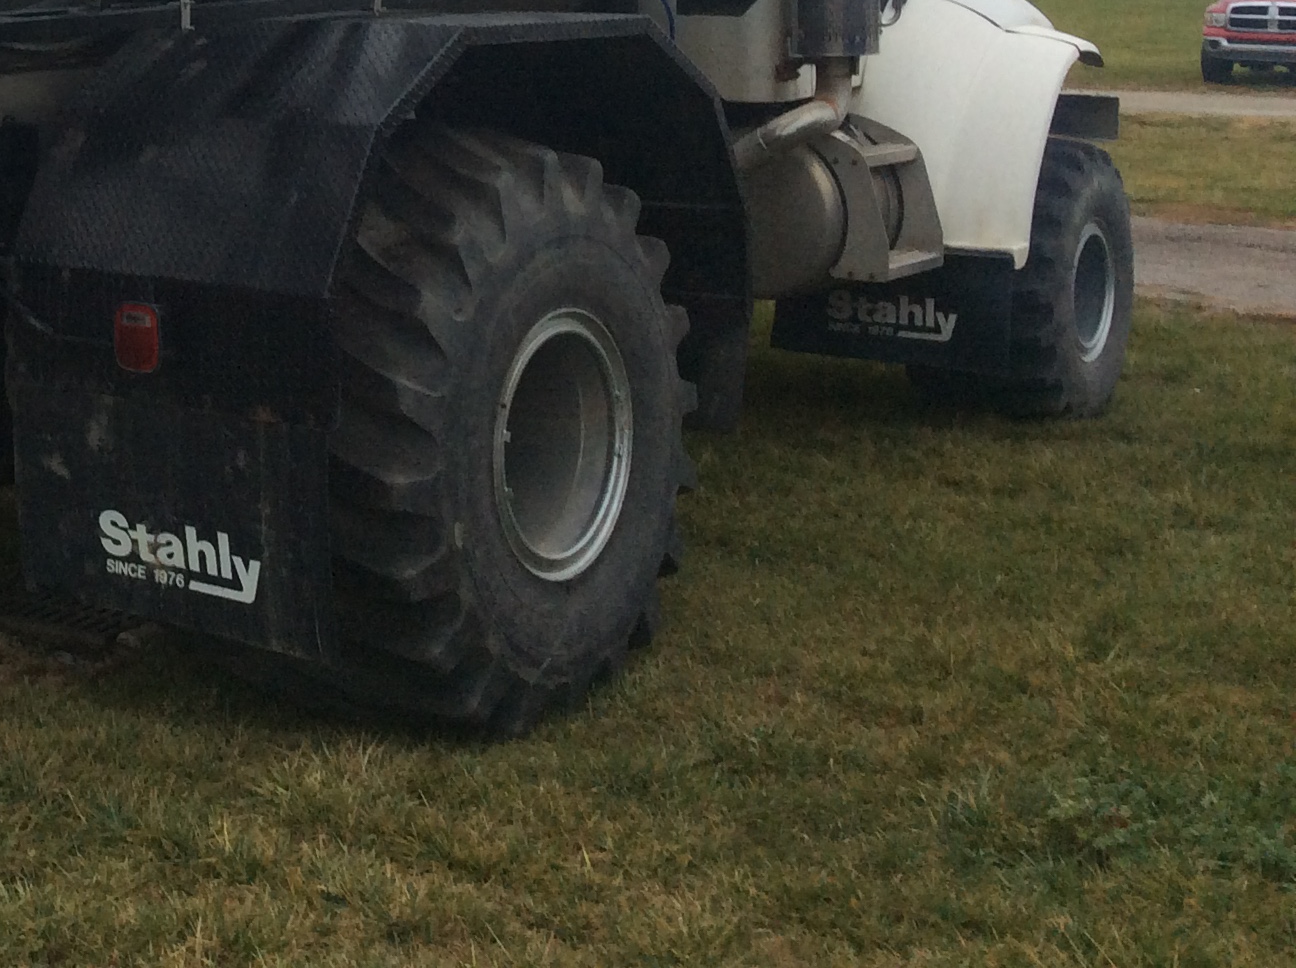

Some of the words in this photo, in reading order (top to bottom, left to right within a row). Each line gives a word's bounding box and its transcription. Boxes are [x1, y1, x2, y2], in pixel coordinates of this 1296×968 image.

[827, 289, 958, 342] Stahly
[99, 509, 261, 604] Stahly
[106, 559, 147, 580] SINCE
[154, 568, 185, 588] 1976
